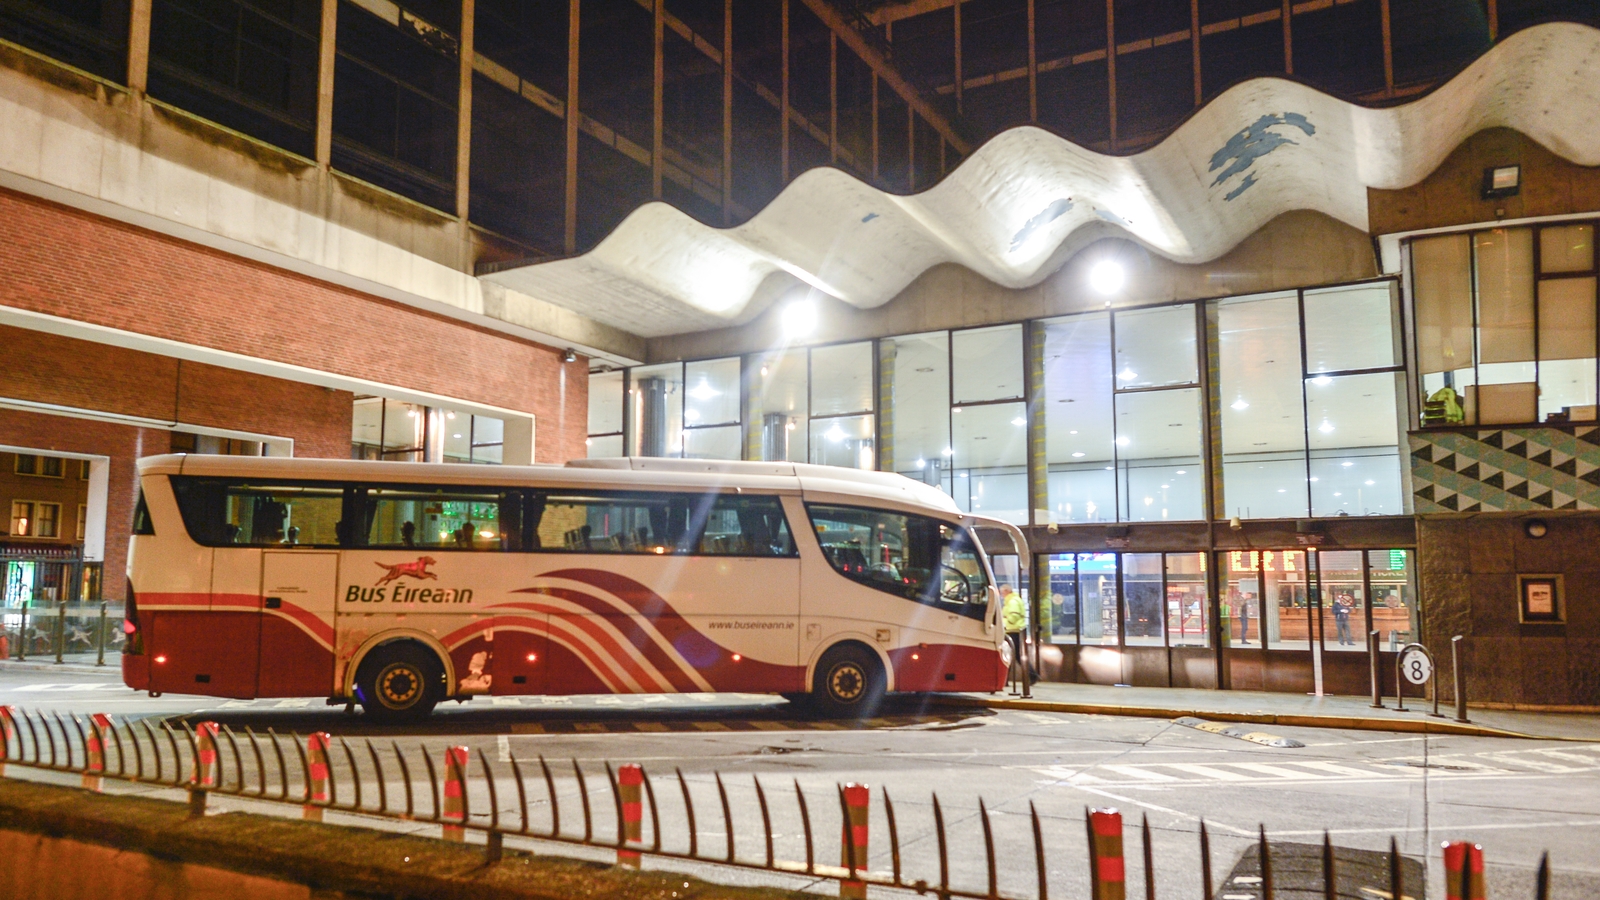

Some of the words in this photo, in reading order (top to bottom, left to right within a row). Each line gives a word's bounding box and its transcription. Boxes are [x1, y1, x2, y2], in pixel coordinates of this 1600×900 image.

[345, 585, 386, 603] Bus
[392, 582, 473, 603] Éireann
[709, 621, 794, 629] www.buseireann.ie
[1411, 660, 1423, 680] 8
